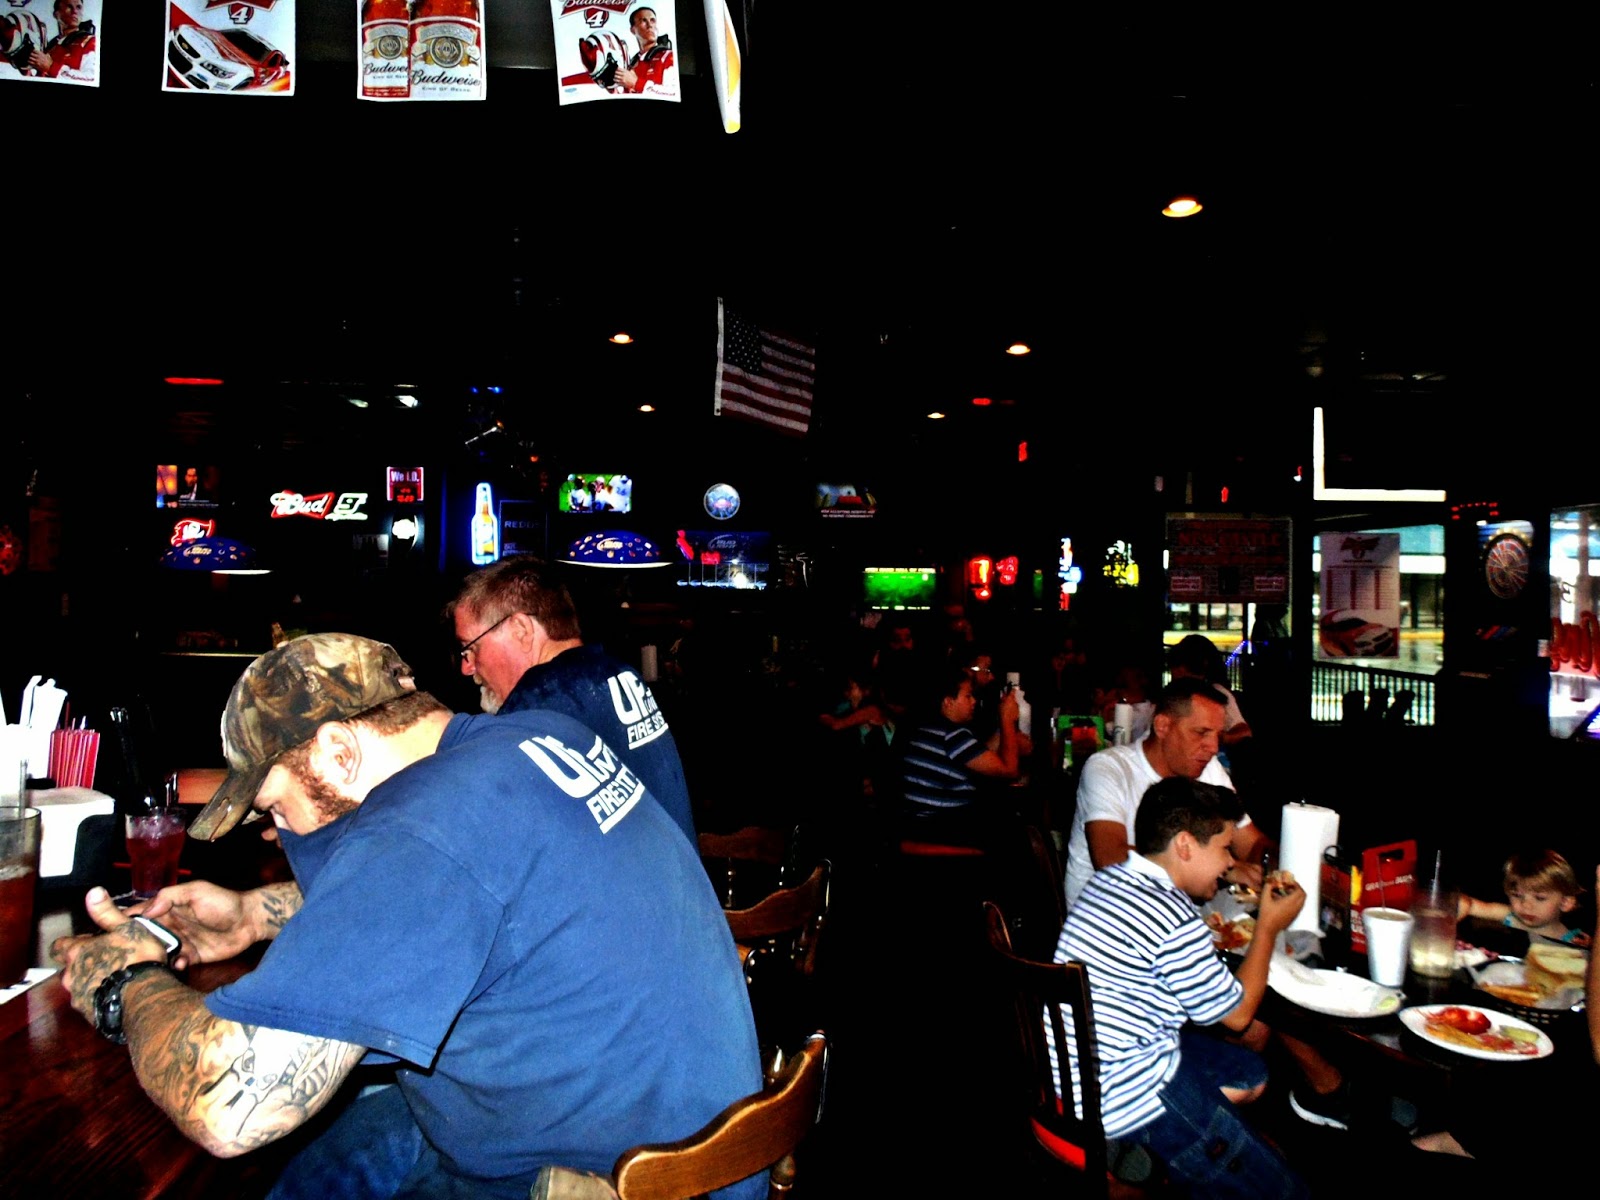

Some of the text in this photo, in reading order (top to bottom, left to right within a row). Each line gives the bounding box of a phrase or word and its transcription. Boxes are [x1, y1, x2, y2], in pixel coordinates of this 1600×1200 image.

[230, 5, 249, 24] 4
[586, 10, 604, 27] 4
[627, 717, 654, 743] FIRE
